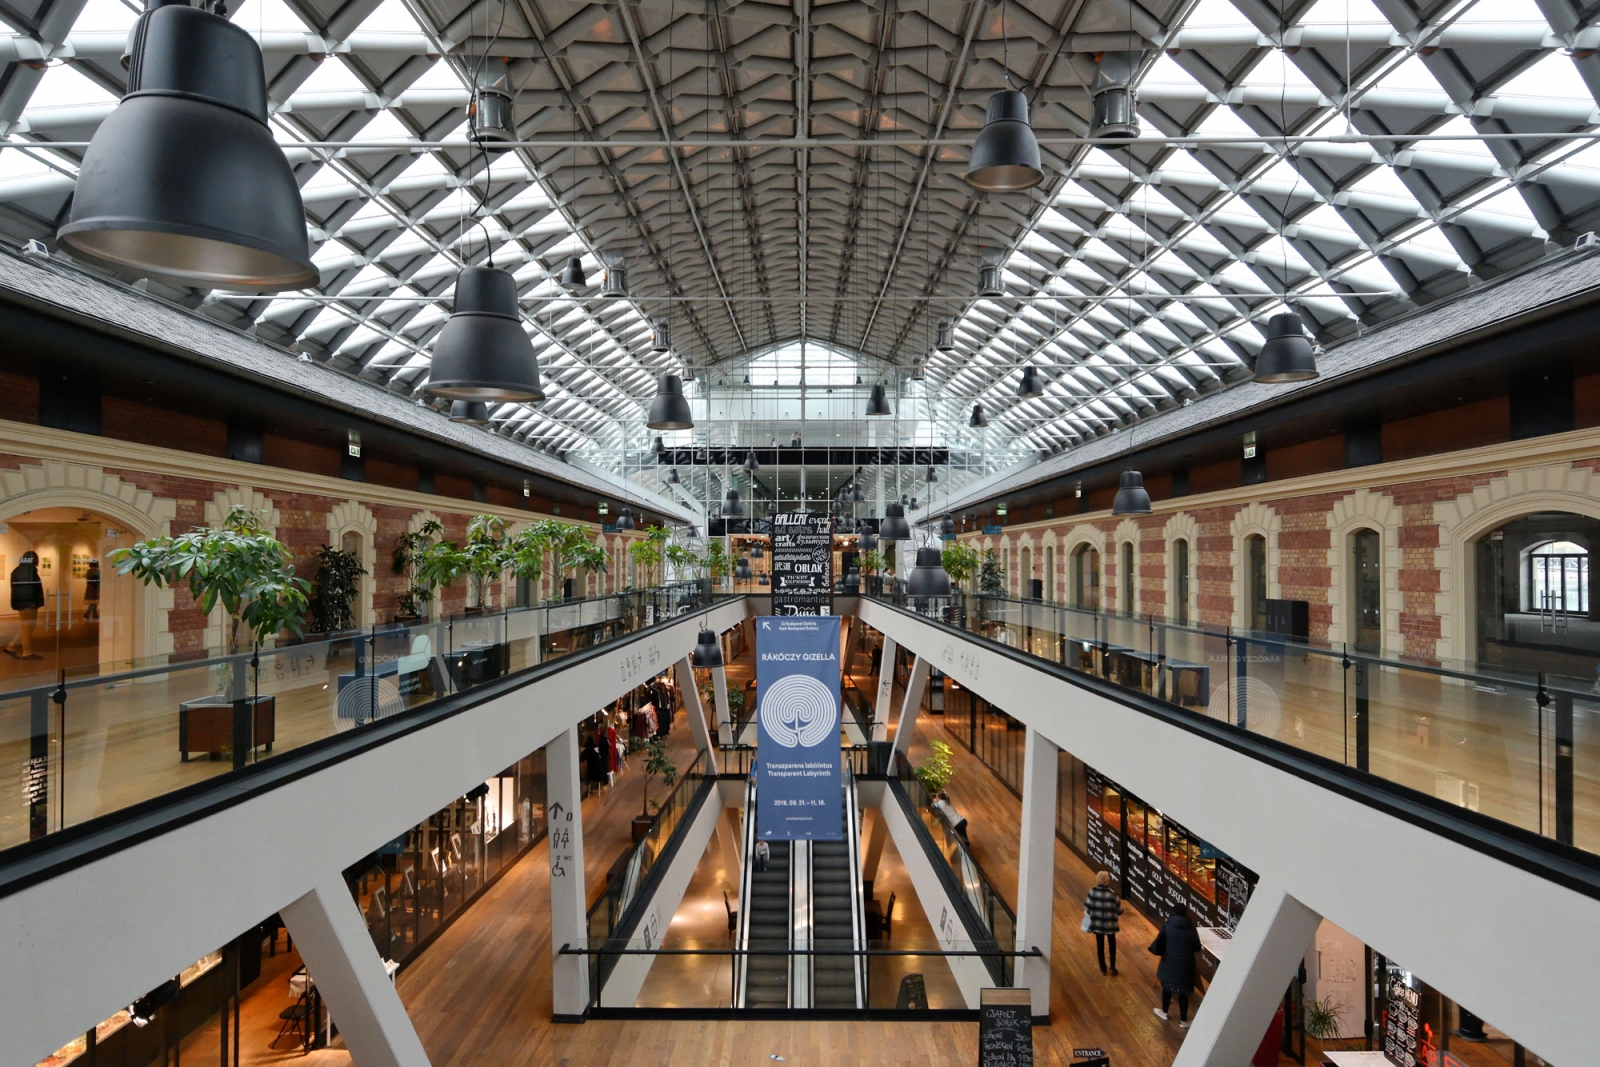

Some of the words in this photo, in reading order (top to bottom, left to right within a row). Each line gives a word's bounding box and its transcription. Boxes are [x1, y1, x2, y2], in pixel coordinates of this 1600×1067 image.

[795, 563, 822, 573] OBLAK
[774, 596, 830, 604] gastromantica
[762, 653, 801, 661] RÁKÓCZY
[1405, 987, 1419, 1007] MENU
[986, 1009, 1017, 1019] CSAPOLT
